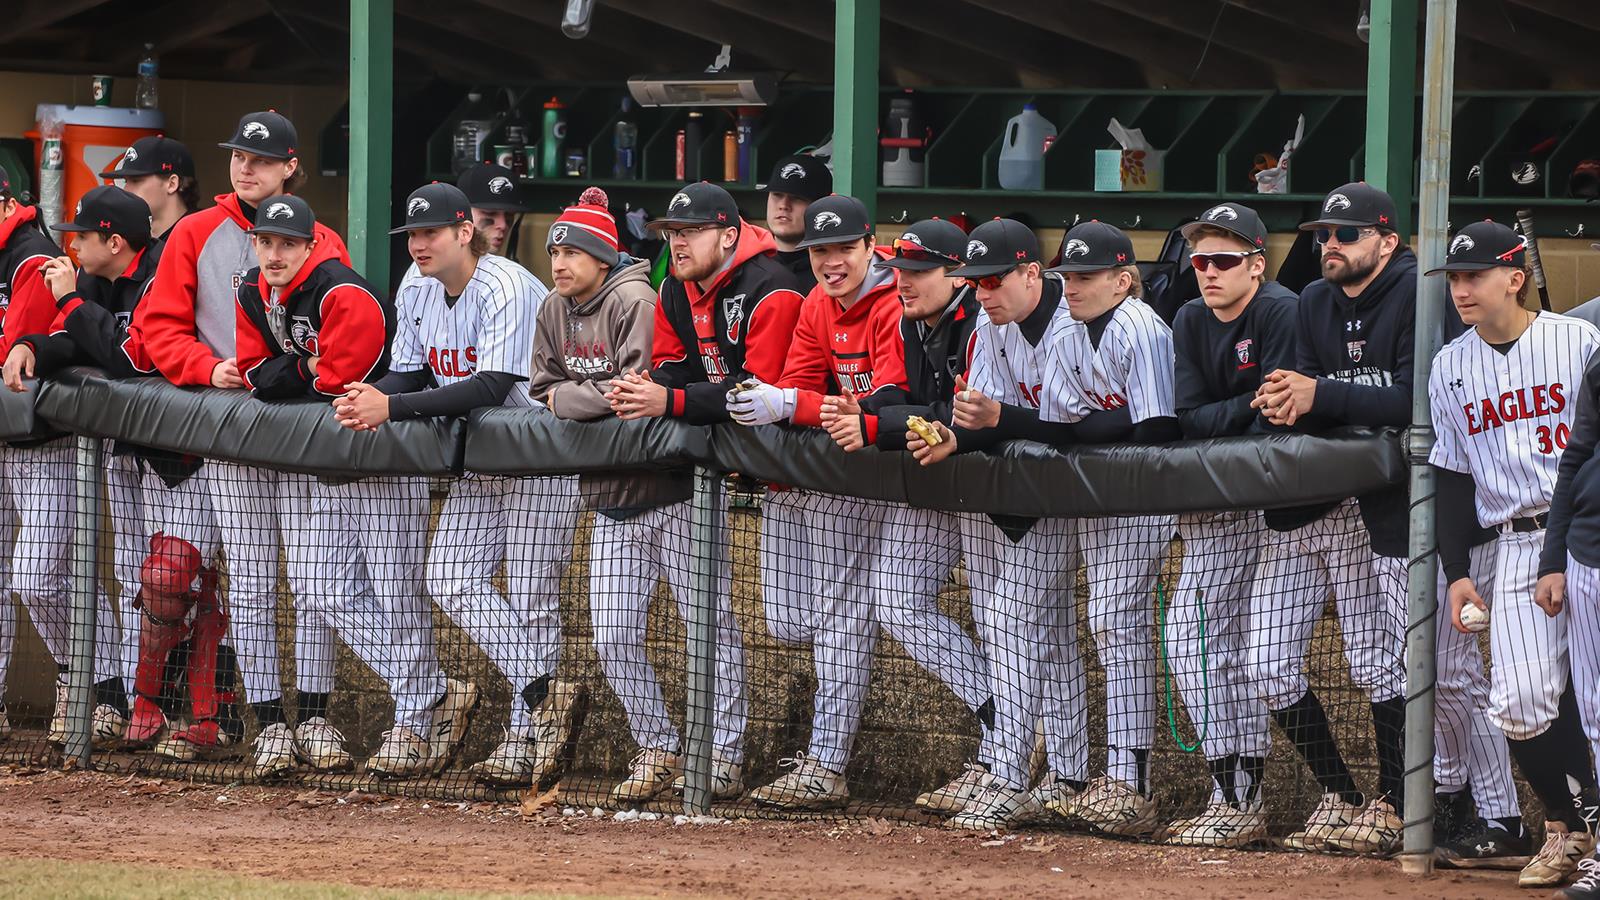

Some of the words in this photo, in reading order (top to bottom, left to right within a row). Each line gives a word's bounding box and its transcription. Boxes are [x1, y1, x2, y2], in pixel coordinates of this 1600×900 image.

[427, 346, 478, 377] AGLS
[1463, 383, 1566, 436] EAGLES
[1536, 422, 1571, 455] 30
